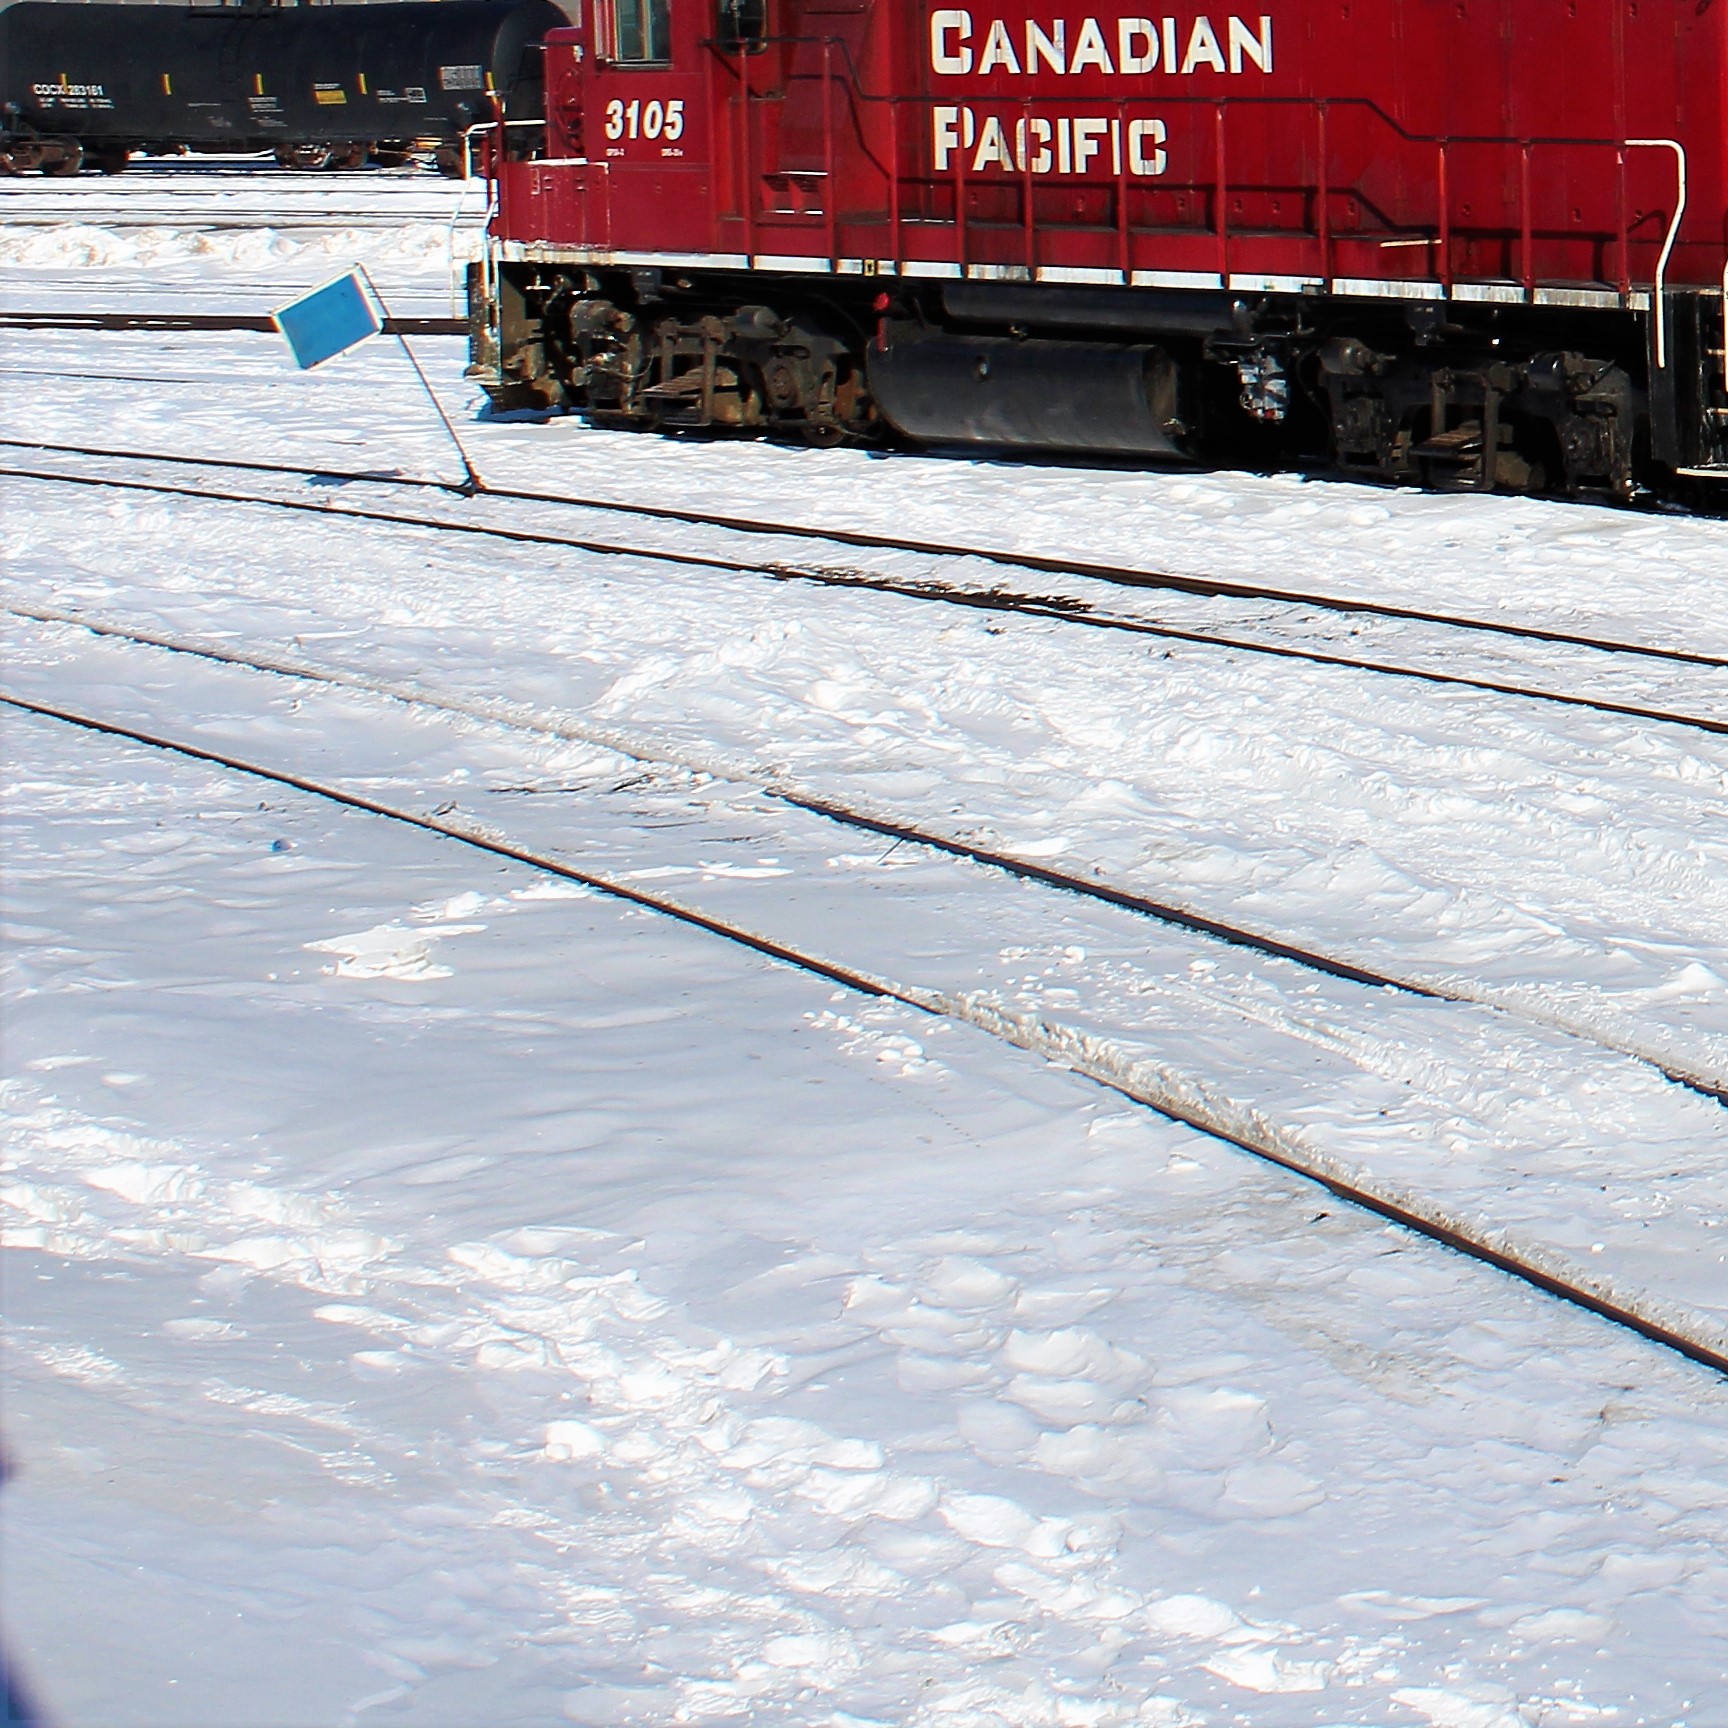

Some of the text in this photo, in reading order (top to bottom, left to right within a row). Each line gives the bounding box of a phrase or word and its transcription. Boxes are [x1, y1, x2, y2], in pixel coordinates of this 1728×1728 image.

[930, 9, 1273, 75] CANADIAN
[605, 99, 684, 140] 3105
[932, 105, 1168, 176] PACIFIC
